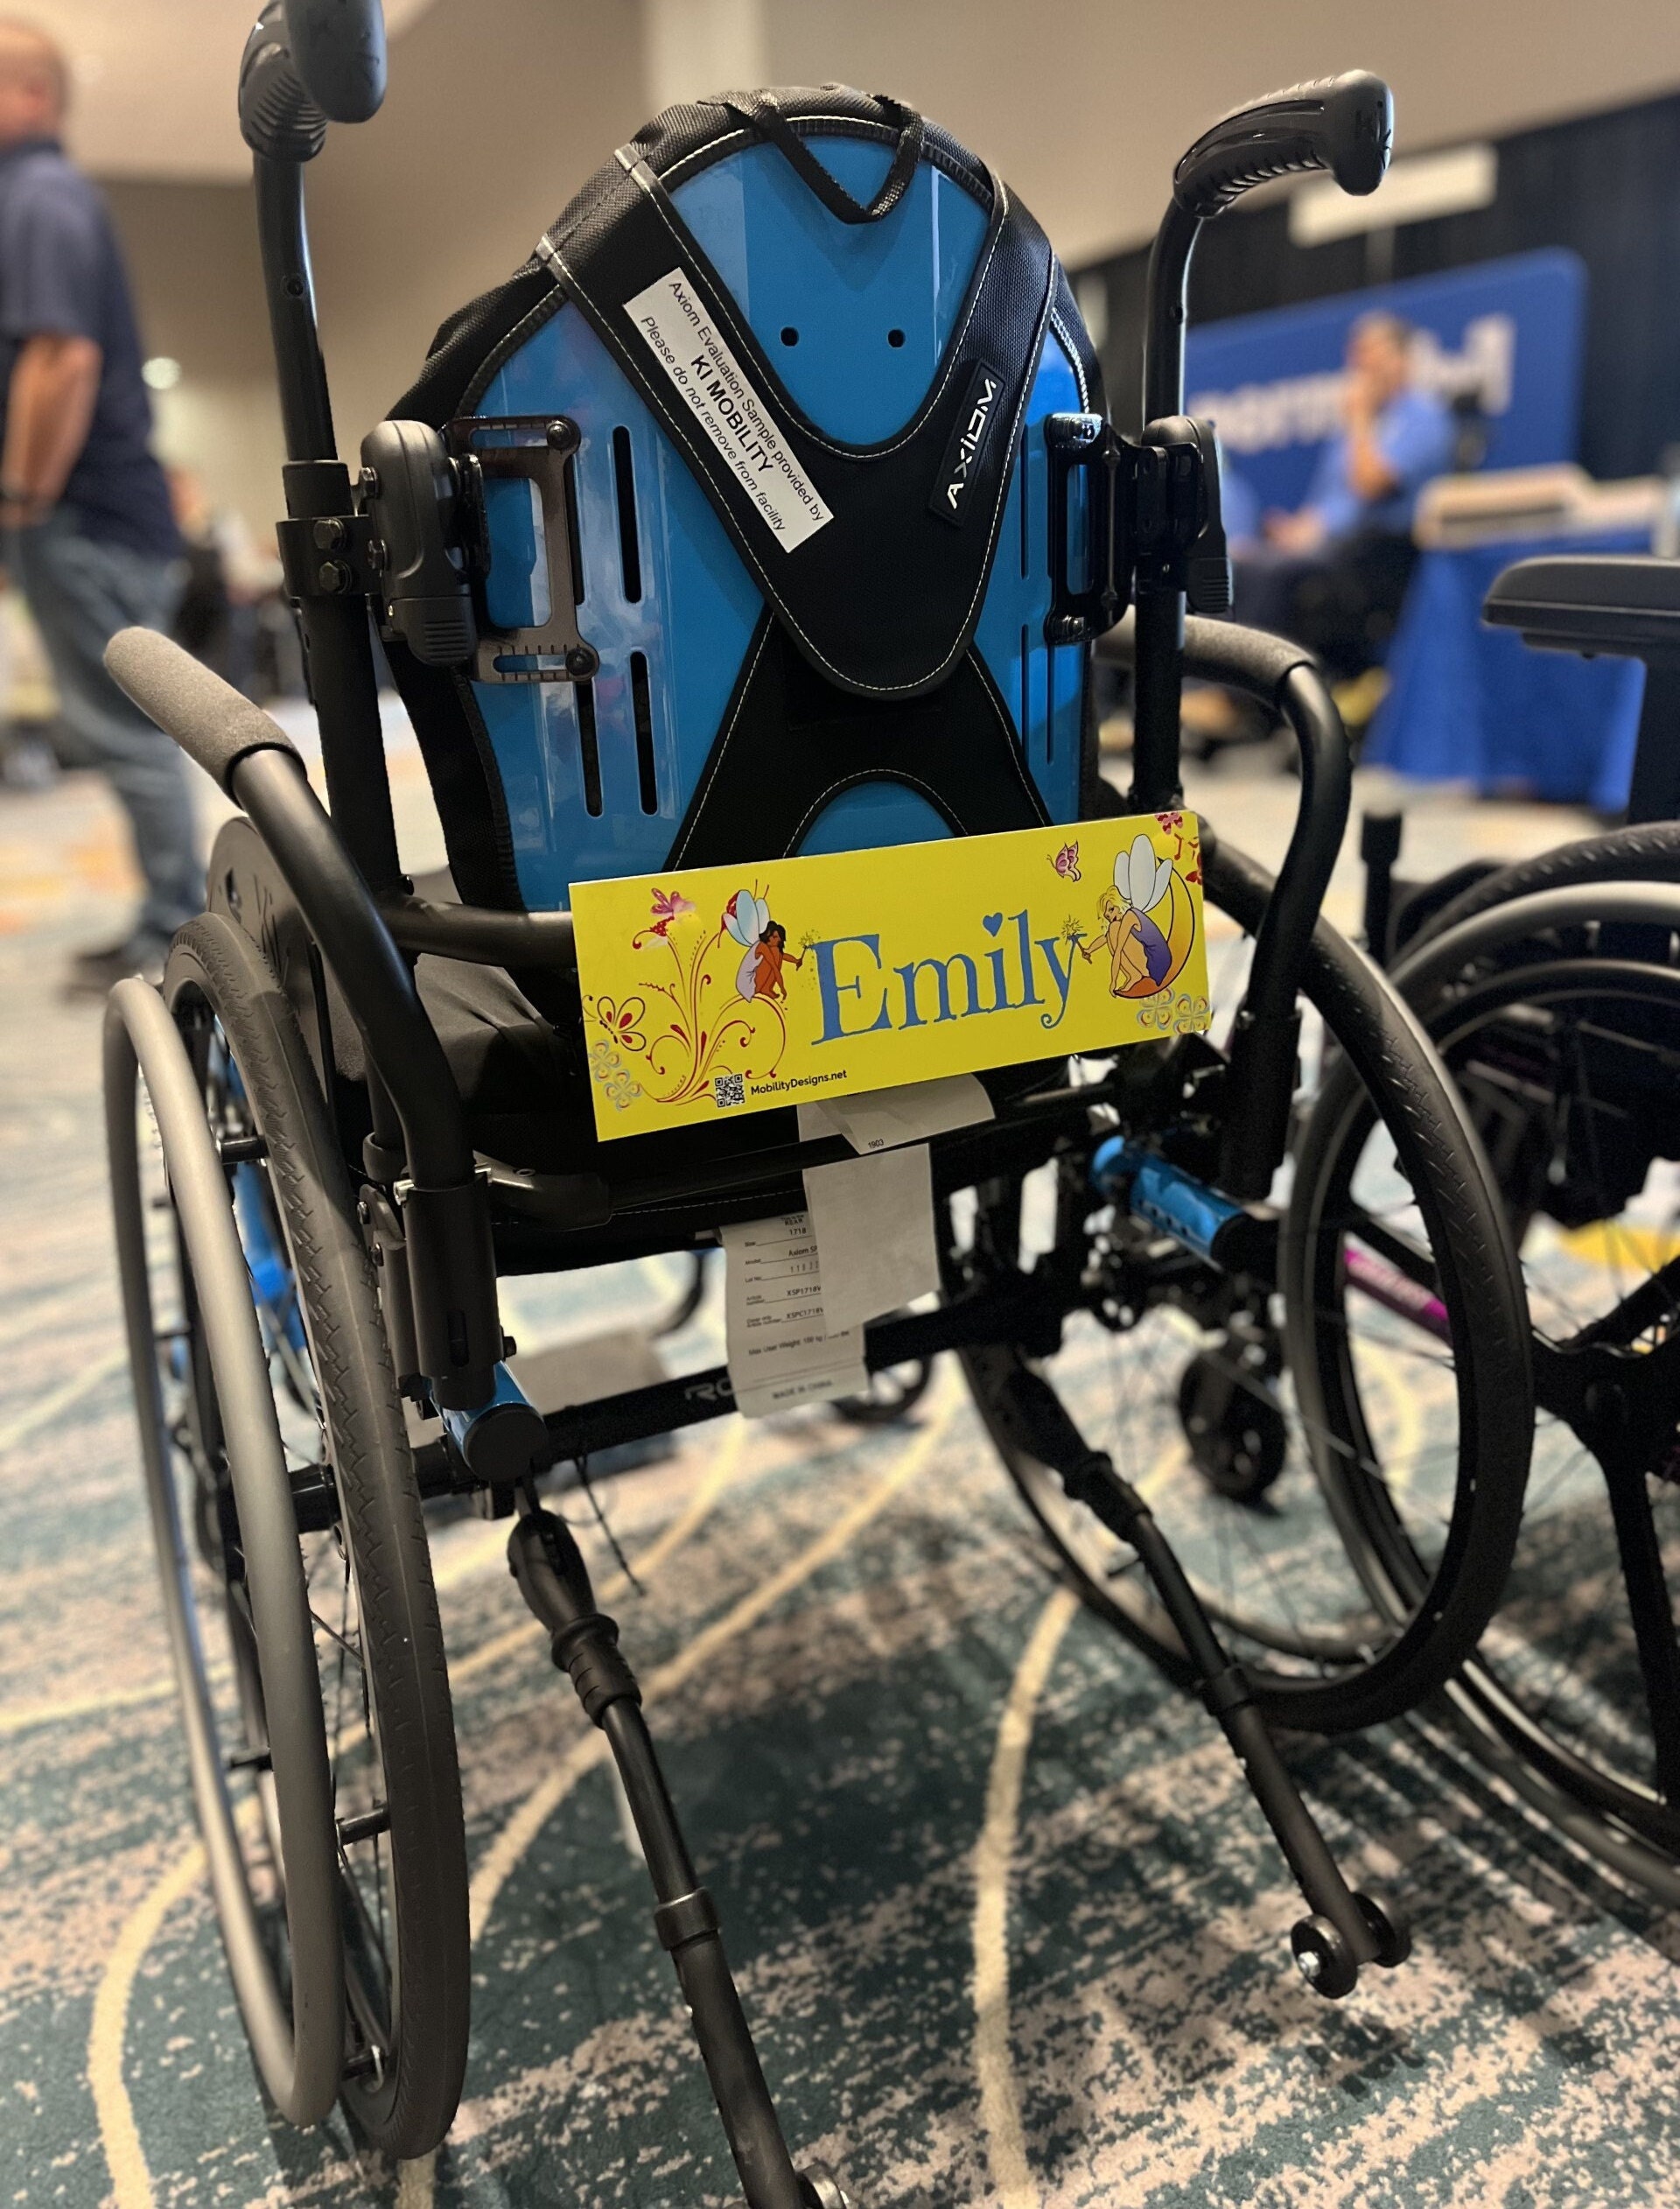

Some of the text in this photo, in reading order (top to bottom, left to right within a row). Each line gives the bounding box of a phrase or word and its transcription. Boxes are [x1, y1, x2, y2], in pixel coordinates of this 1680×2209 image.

[640, 316, 786, 530] Please do not remove from facility
[668, 282, 824, 521] Axiom Evaluation Sample provided by
[690, 354, 774, 472] KI MOBILITY
[808, 908, 1088, 1046] Emily
[751, 1069, 848, 1096] MobilityDesigns.net
[868, 1138, 885, 1149] 1903
